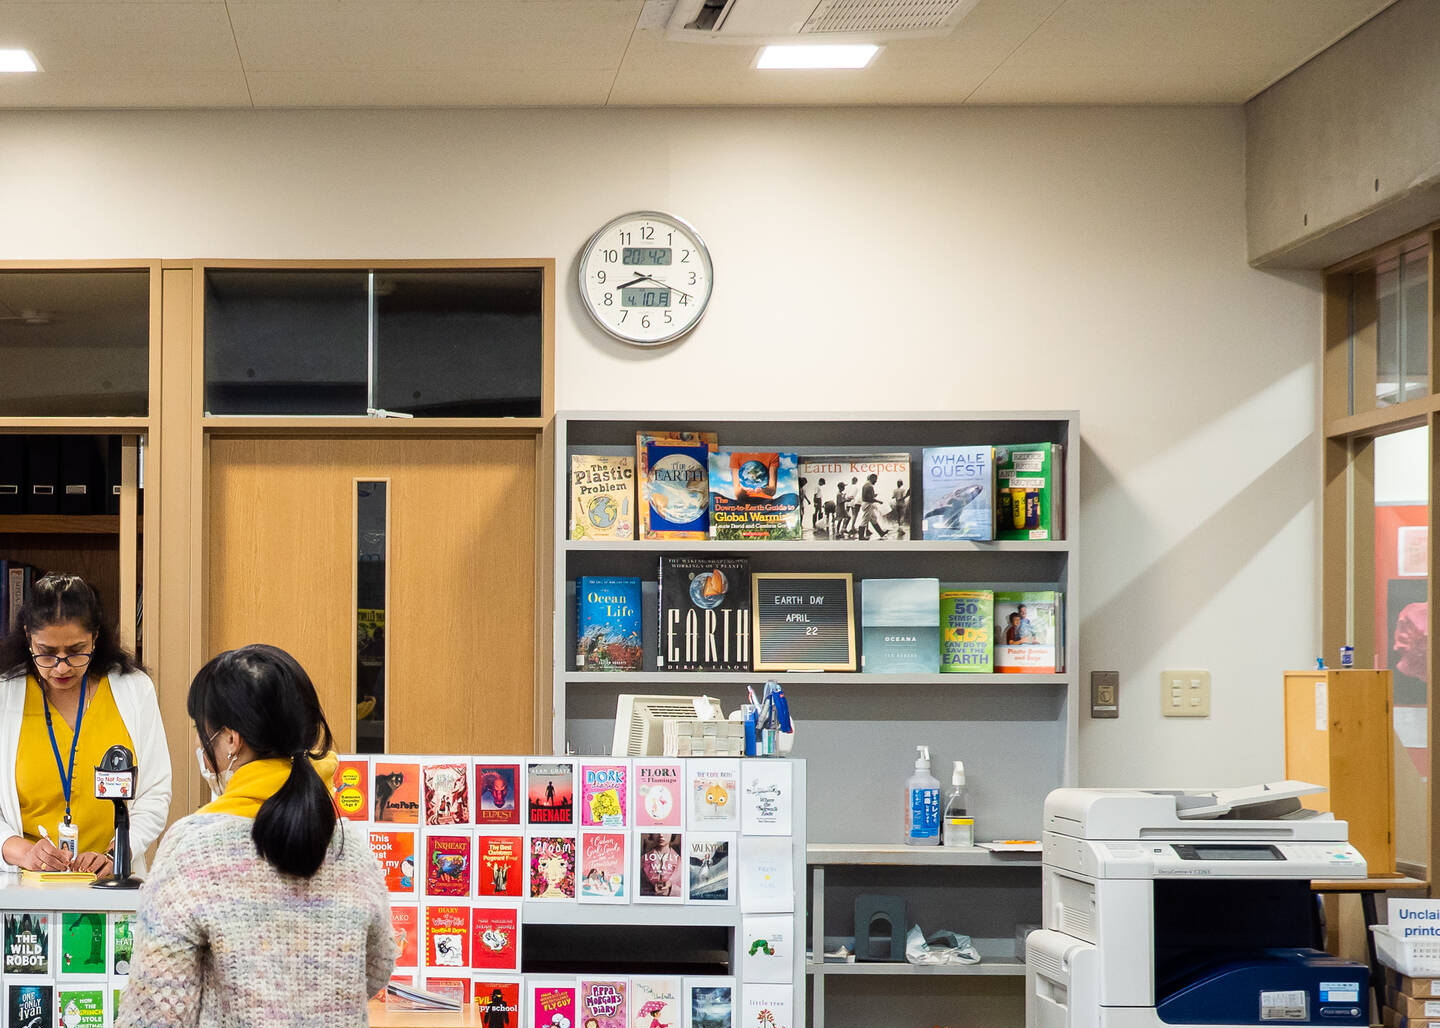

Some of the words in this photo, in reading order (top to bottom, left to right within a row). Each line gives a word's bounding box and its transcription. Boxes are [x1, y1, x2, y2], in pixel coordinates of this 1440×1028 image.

[620, 232, 631, 246] 11
[667, 233, 672, 246] 1
[640, 226, 655, 240] 12
[603, 249, 618, 263] 10
[680, 249, 690, 263] 2
[597, 270, 606, 284] 9
[688, 271, 697, 285] 3
[604, 292, 613, 306] 8
[679, 293, 688, 307] 4
[620, 310, 628, 323] 7
[664, 310, 672, 323] 5
[641, 315, 650, 328] 6
[931, 454, 985, 466] WHALE
[591, 464, 608, 473] The
[803, 462, 843, 474] Earth
[849, 460, 907, 475] Keepers
[930, 465, 986, 477] QUEST
[574, 466, 633, 485] Plastic
[654, 470, 705, 482] EARTH
[580, 482, 628, 495] Problem
[714, 503, 763, 512] Down-to-Earth
[715, 512, 748, 523] Global
[587, 592, 627, 604] Ocean
[774, 596, 803, 605] EARTH
[810, 596, 824, 605] DAY
[606, 605, 635, 617] Life
[955, 603, 978, 615] 50
[785, 614, 810, 622] APRIL
[667, 608, 750, 662] EARTH
[806, 627, 818, 635] 22
[943, 654, 989, 665] EARTH
[586, 770, 625, 784] DORK
[641, 768, 677, 777] FLORA
[530, 808, 571, 822] GRENADE
[369, 834, 389, 843] This
[369, 843, 392, 851] book
[644, 853, 680, 863] LOVELY
[651, 862, 674, 871] WAR
[15, 934, 38, 944] THE
[10, 944, 43, 955] WILD
[6, 955, 46, 966] ROBOT
[22, 991, 35, 1001] ONE
[491, 1003, 518, 1012] school
